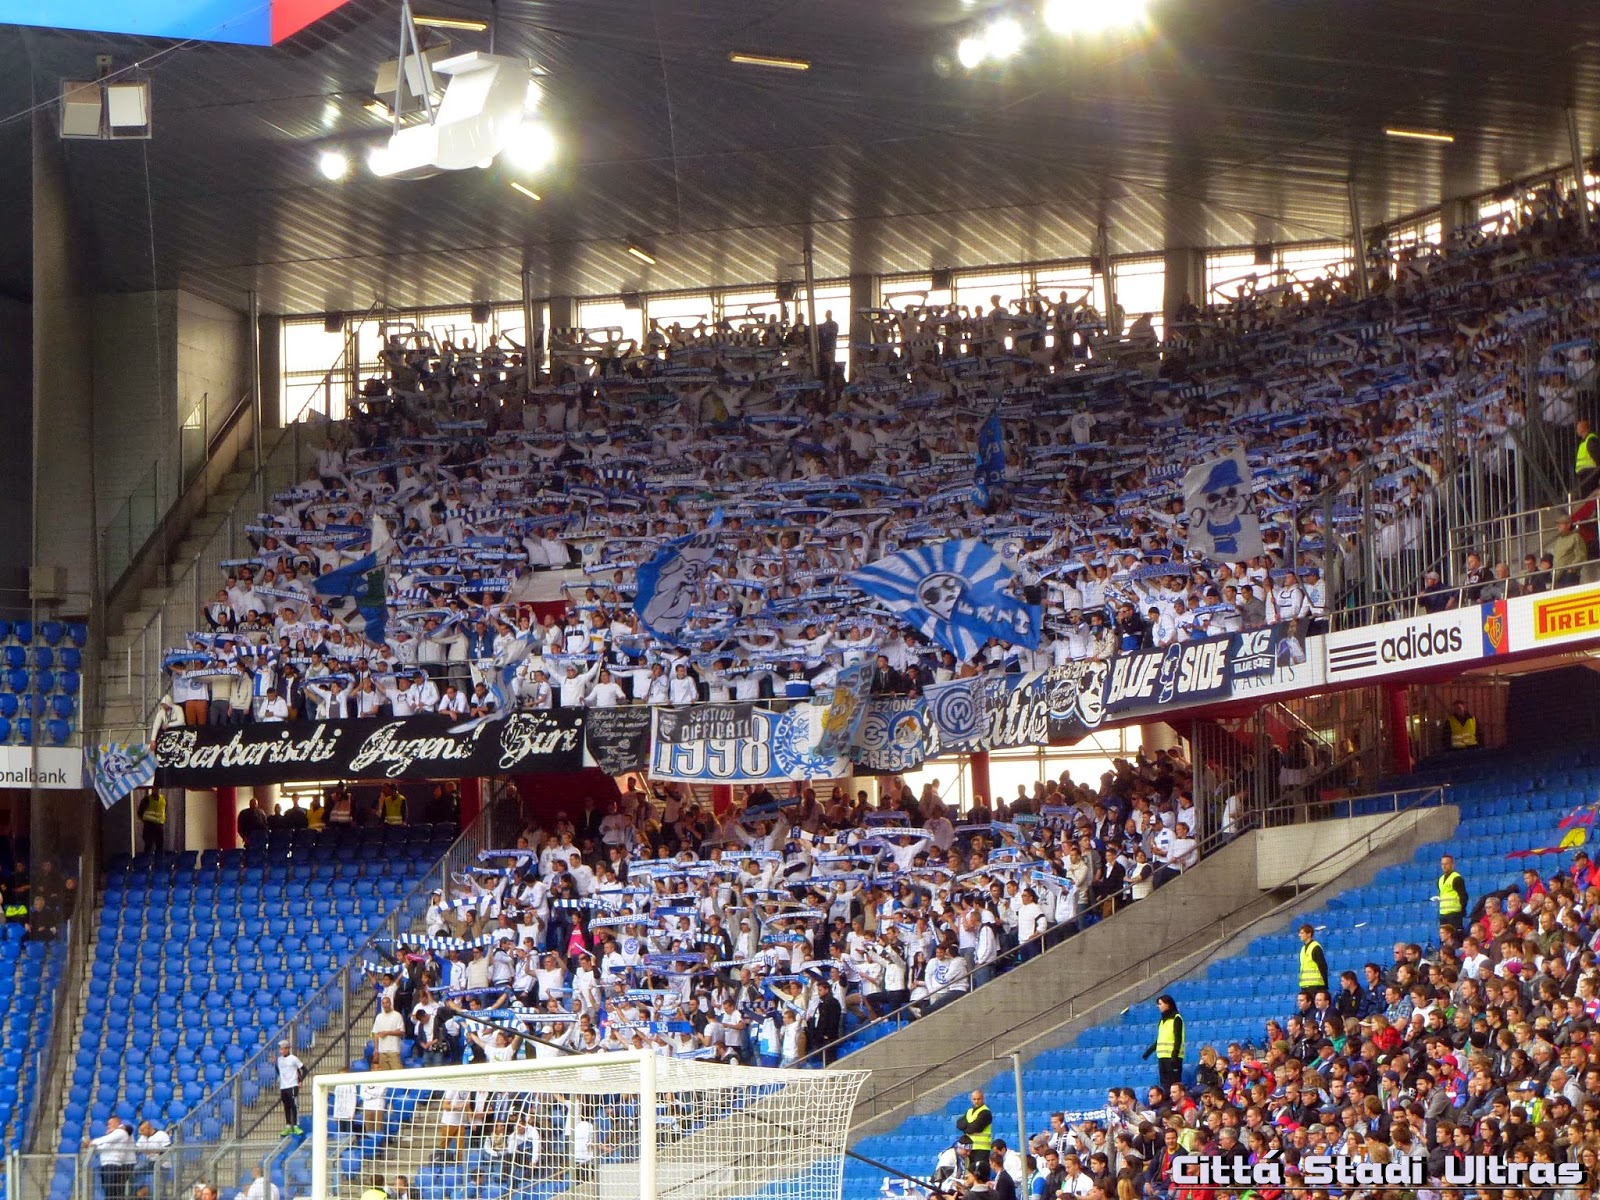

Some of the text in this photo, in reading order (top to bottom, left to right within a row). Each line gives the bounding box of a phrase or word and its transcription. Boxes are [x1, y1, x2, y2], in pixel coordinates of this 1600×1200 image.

[1381, 623, 1462, 663] adidas
[1107, 652, 1164, 706] BLUE
[1176, 640, 1230, 693] SIDE
[499, 713, 583, 769] Züri
[654, 713, 770, 777] 1998
[590, 914, 647, 926] RASSHOPPERS
